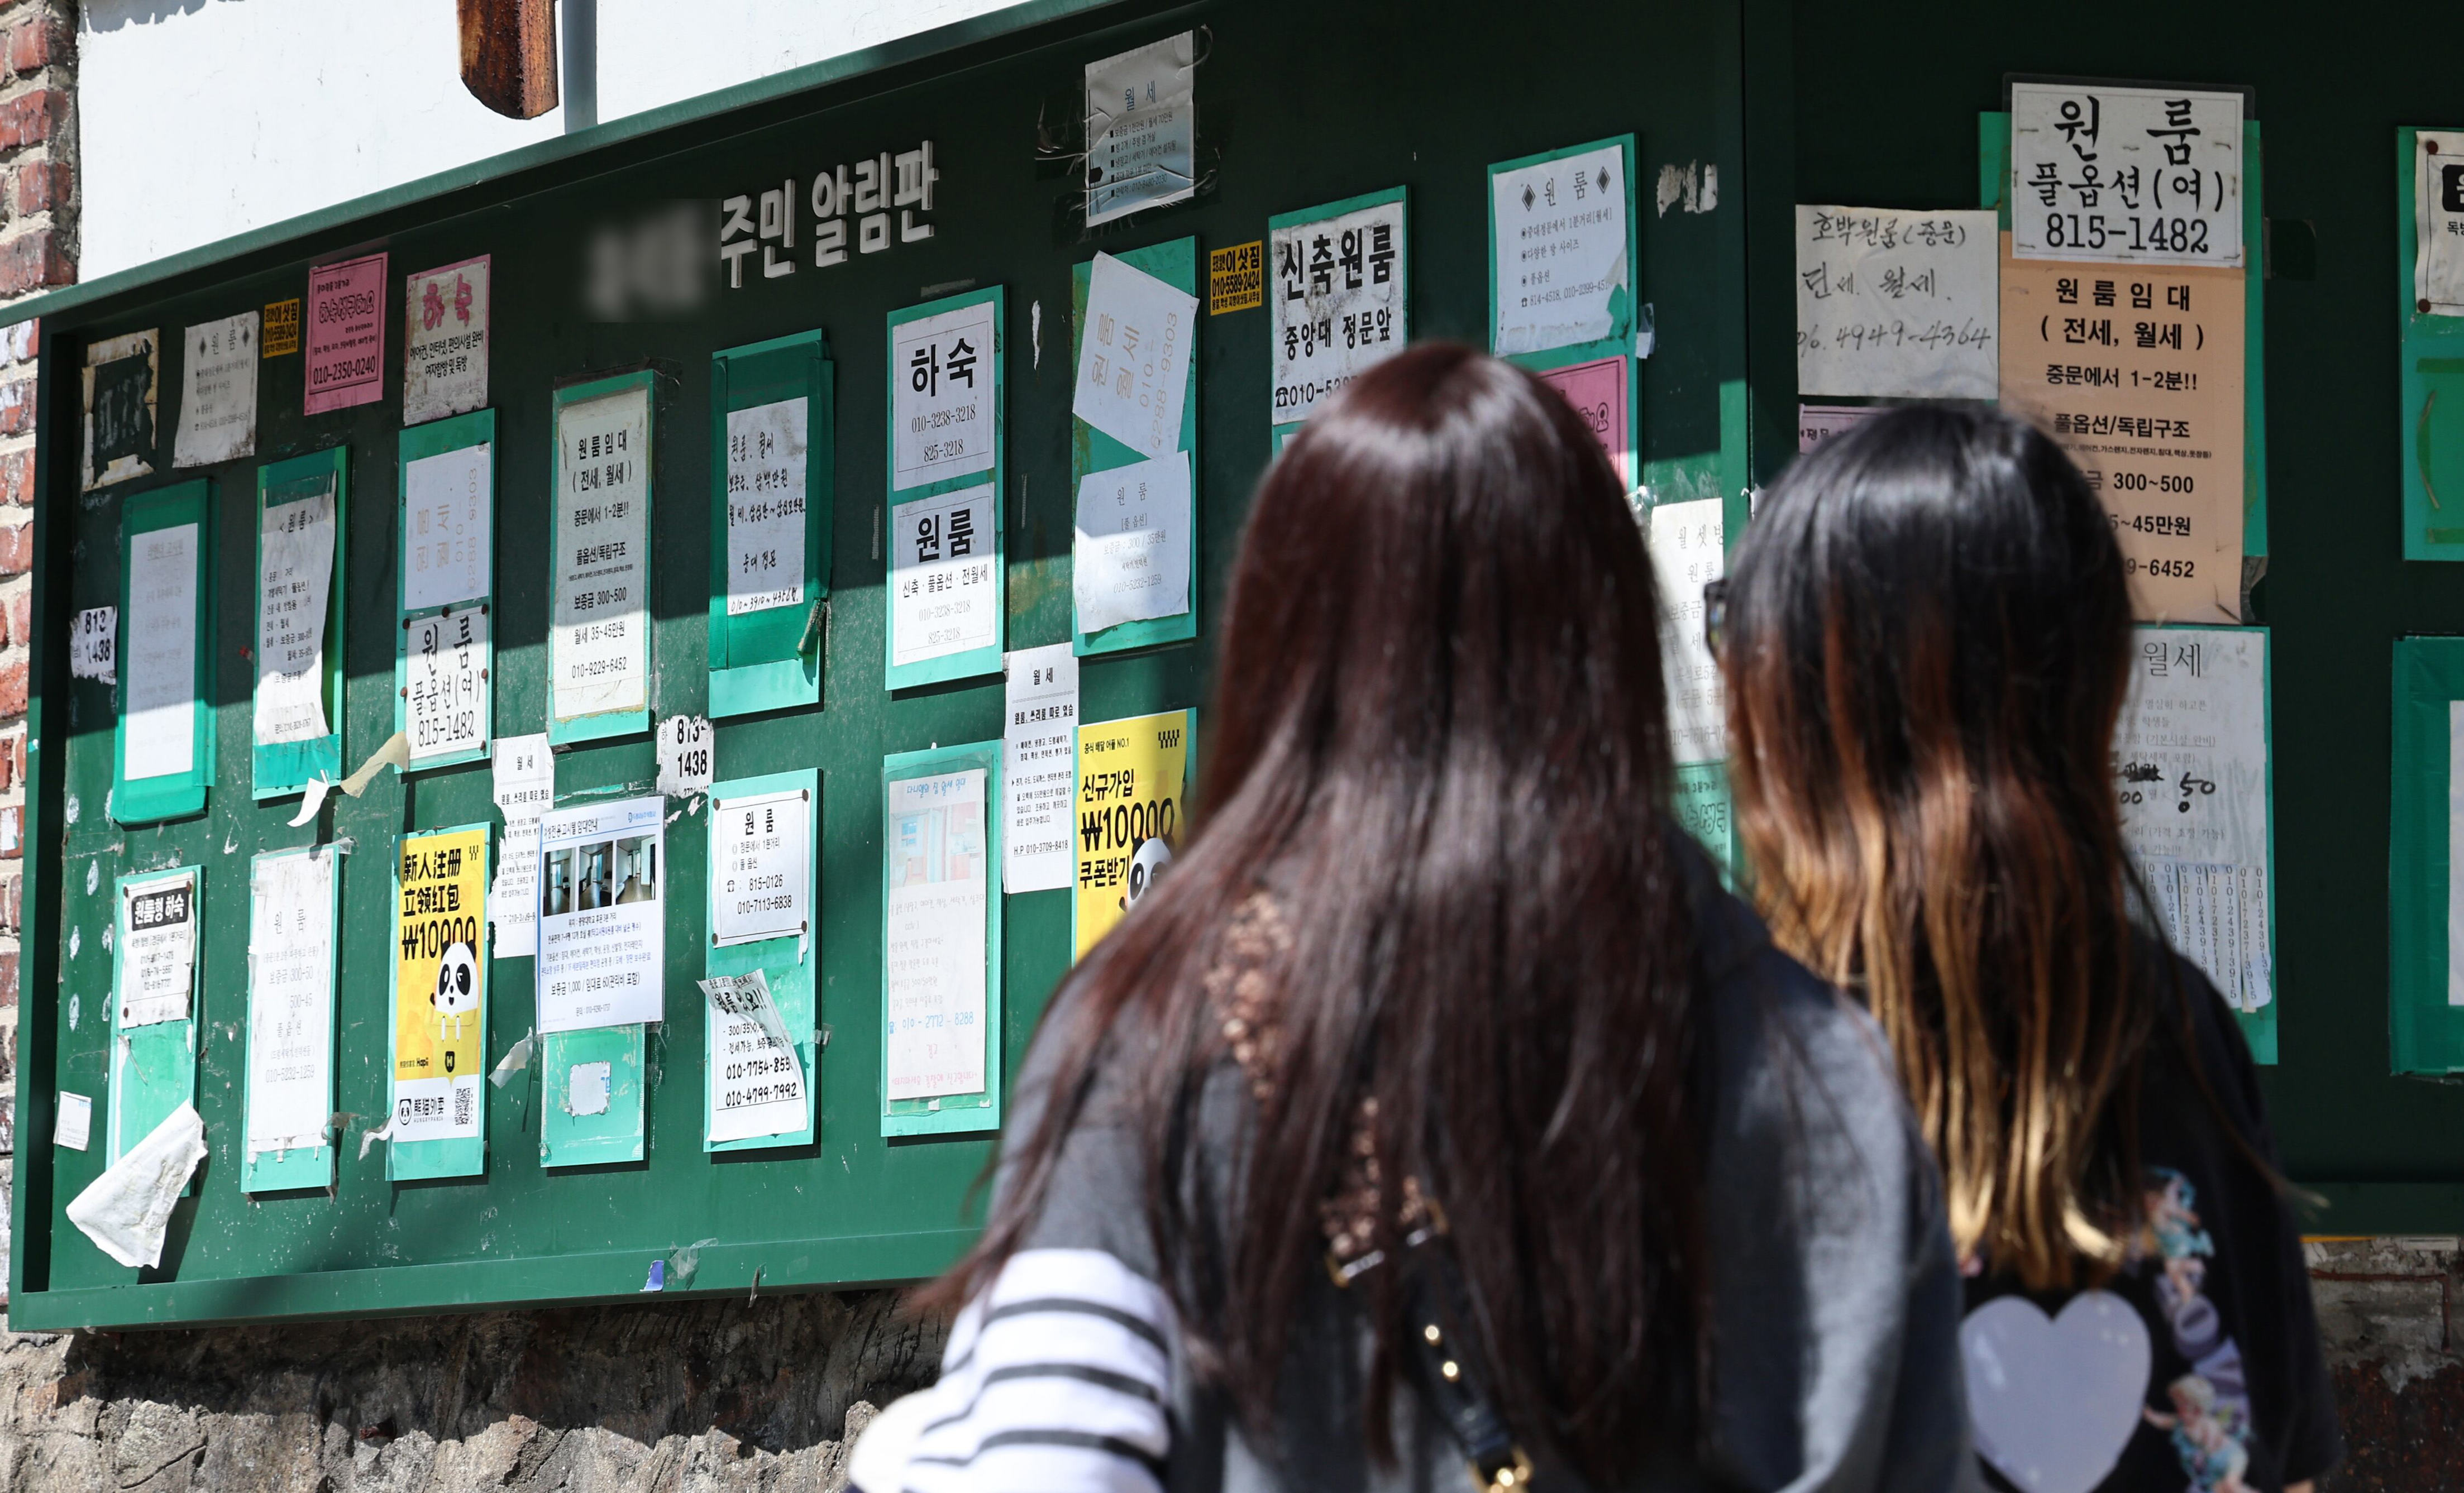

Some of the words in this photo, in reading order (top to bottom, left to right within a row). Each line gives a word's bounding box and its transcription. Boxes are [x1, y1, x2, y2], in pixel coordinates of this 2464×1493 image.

[721, 179, 795, 289] 주민
[811, 140, 939, 268] 알림판
[2046, 213, 2208, 253] 815-1482
[1281, 224, 1395, 300] 신축원룸
[448, 333, 471, 354] 편의시설
[472, 329, 484, 348] 완비
[1285, 318, 1331, 361] 중앙대
[1343, 307, 1392, 350] 정문앞
[314, 356, 376, 385] 010-2350-0240
[426, 361, 448, 378] 여자합방
[455, 356, 467, 373] 독방
[911, 338, 977, 397] 하숙
[2046, 364, 2119, 387] 중문에서
[2131, 371, 2197, 391] 1-2분!!
[912, 404, 976, 434] 010-3238-3218
[924, 438, 964, 462] 825-3218
[2113, 472, 2194, 494] 300~500
[574, 506, 600, 527] 중문에서
[605, 501, 629, 520] 1-2분!!
[2109, 514, 2191, 536] 5~45만원
[916, 508, 974, 563] 원룸
[902, 580, 919, 599] 신축
[962, 563, 988, 586] 전월세
[1113, 573, 1162, 595] 010-5232-1259
[574, 592, 594, 611] 보증금
[596, 587, 627, 606] 300~500
[919, 599, 971, 622] 010-3238-3218
[574, 627, 588, 645] 월세
[591, 620, 625, 640] 35~45만원
[928, 626, 961, 645] 825-3218
[85, 638, 111, 663] 1438
[2142, 642, 2201, 678] 월세
[572, 656, 627, 679] 010-9229-6452
[418, 710, 474, 747] 815-1482
[1085, 741, 1094, 754] 중식
[1095, 739, 1105, 753] 배달
[1106, 738, 1116, 752] 어플
[1117, 737, 1130, 749] NO.1
[678, 749, 707, 777] 1438
[1082, 768, 1135, 803] 신규가입
[1014, 845, 1024, 856] H.P
[1026, 840, 1068, 854] 010-3709-8418
[404, 849, 461, 883] 新人注册
[1080, 855, 1131, 889] 쿠폰받기
[749, 874, 783, 891] 815-0126
[404, 883, 460, 917] 立领红包
[737, 894, 792, 915] 010-7113-6838
[551, 982, 566, 997] 보증금
[726, 1082, 797, 1107] 010-4799-7992
